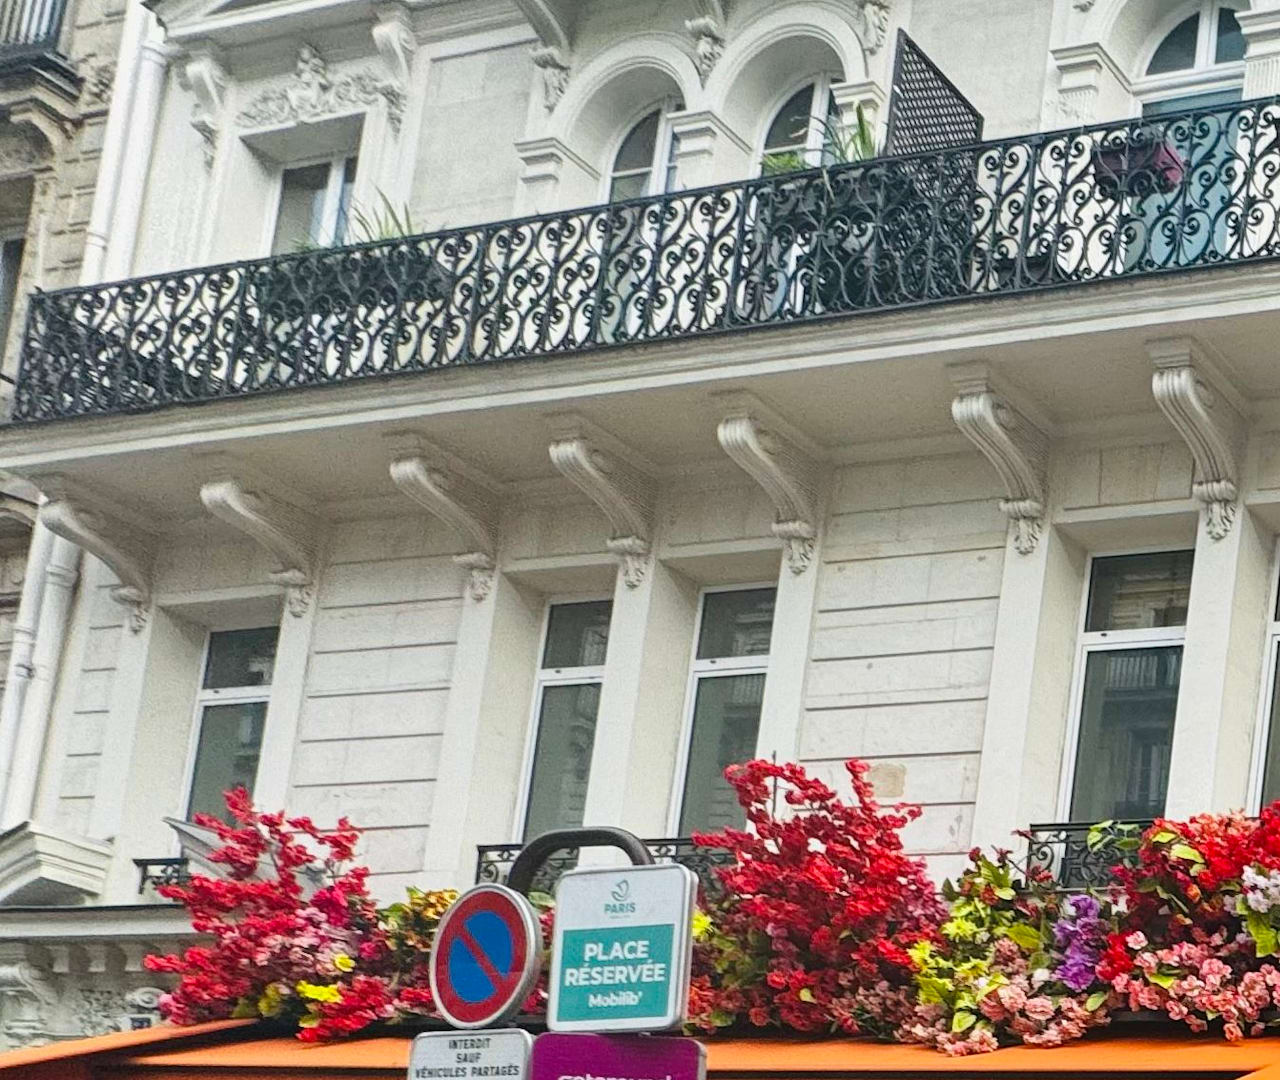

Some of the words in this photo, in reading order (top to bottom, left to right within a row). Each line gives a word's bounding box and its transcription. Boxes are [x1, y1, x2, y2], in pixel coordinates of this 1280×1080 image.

[604, 902, 636, 915] PARIS
[584, 940, 650, 962] PLACE
[564, 959, 666, 987] RÉSERVÉE
[448, 1038, 491, 1050] INTERDIT
[456, 1052, 482, 1064] SAUF
[415, 1065, 468, 1079] VÉHICULES
[471, 1064, 520, 1077] PARTAGÉS
